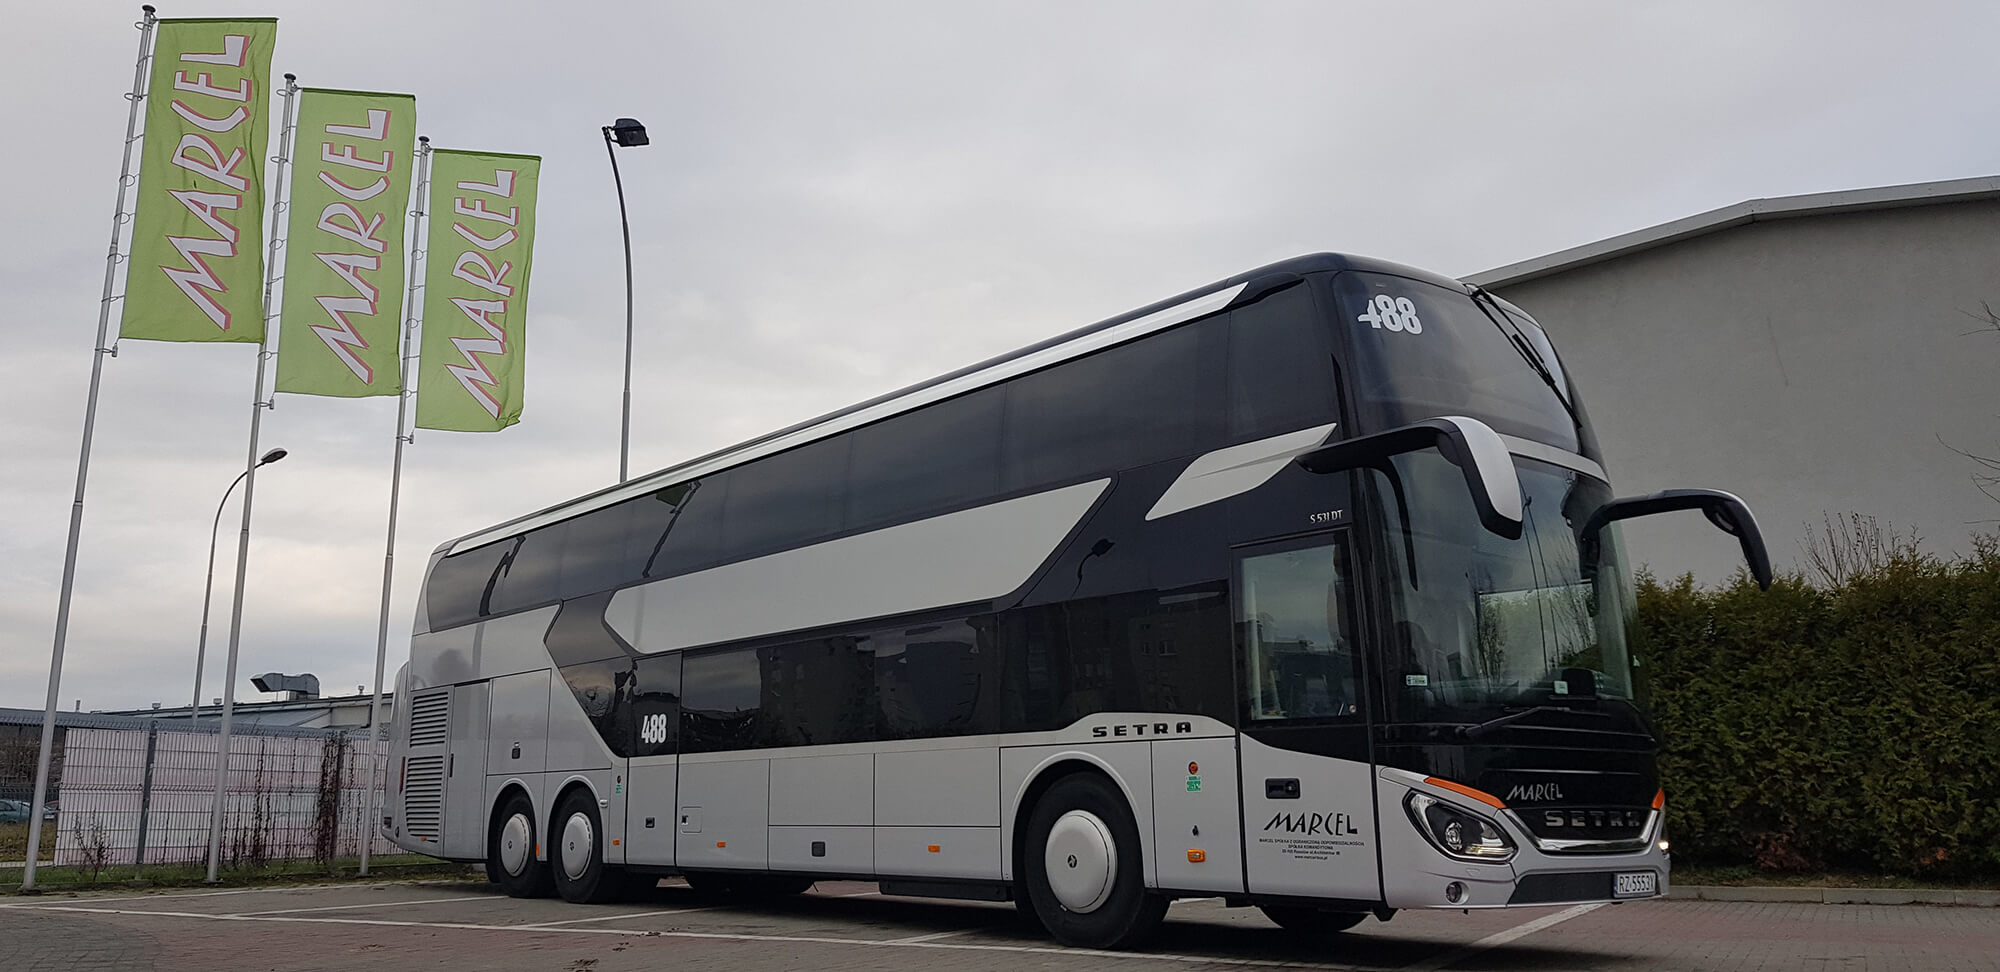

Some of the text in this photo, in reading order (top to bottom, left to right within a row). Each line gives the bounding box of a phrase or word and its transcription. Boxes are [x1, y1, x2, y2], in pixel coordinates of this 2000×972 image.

[159, 34, 251, 331] MARCEL
[309, 108, 393, 385] MARCEL
[444, 169, 520, 420] MARCEL
[1357, 294, 1423, 335] 488
[1310, 509, 1343, 523] S 531 DT
[641, 713, 667, 743] 488
[1092, 721, 1192, 738] SETRA
[1506, 782, 1563, 801] MARCEL
[1263, 812, 1358, 836] MARCEL
[1545, 810, 1640, 827] SETRA
[1619, 875, 1630, 892] RZ
